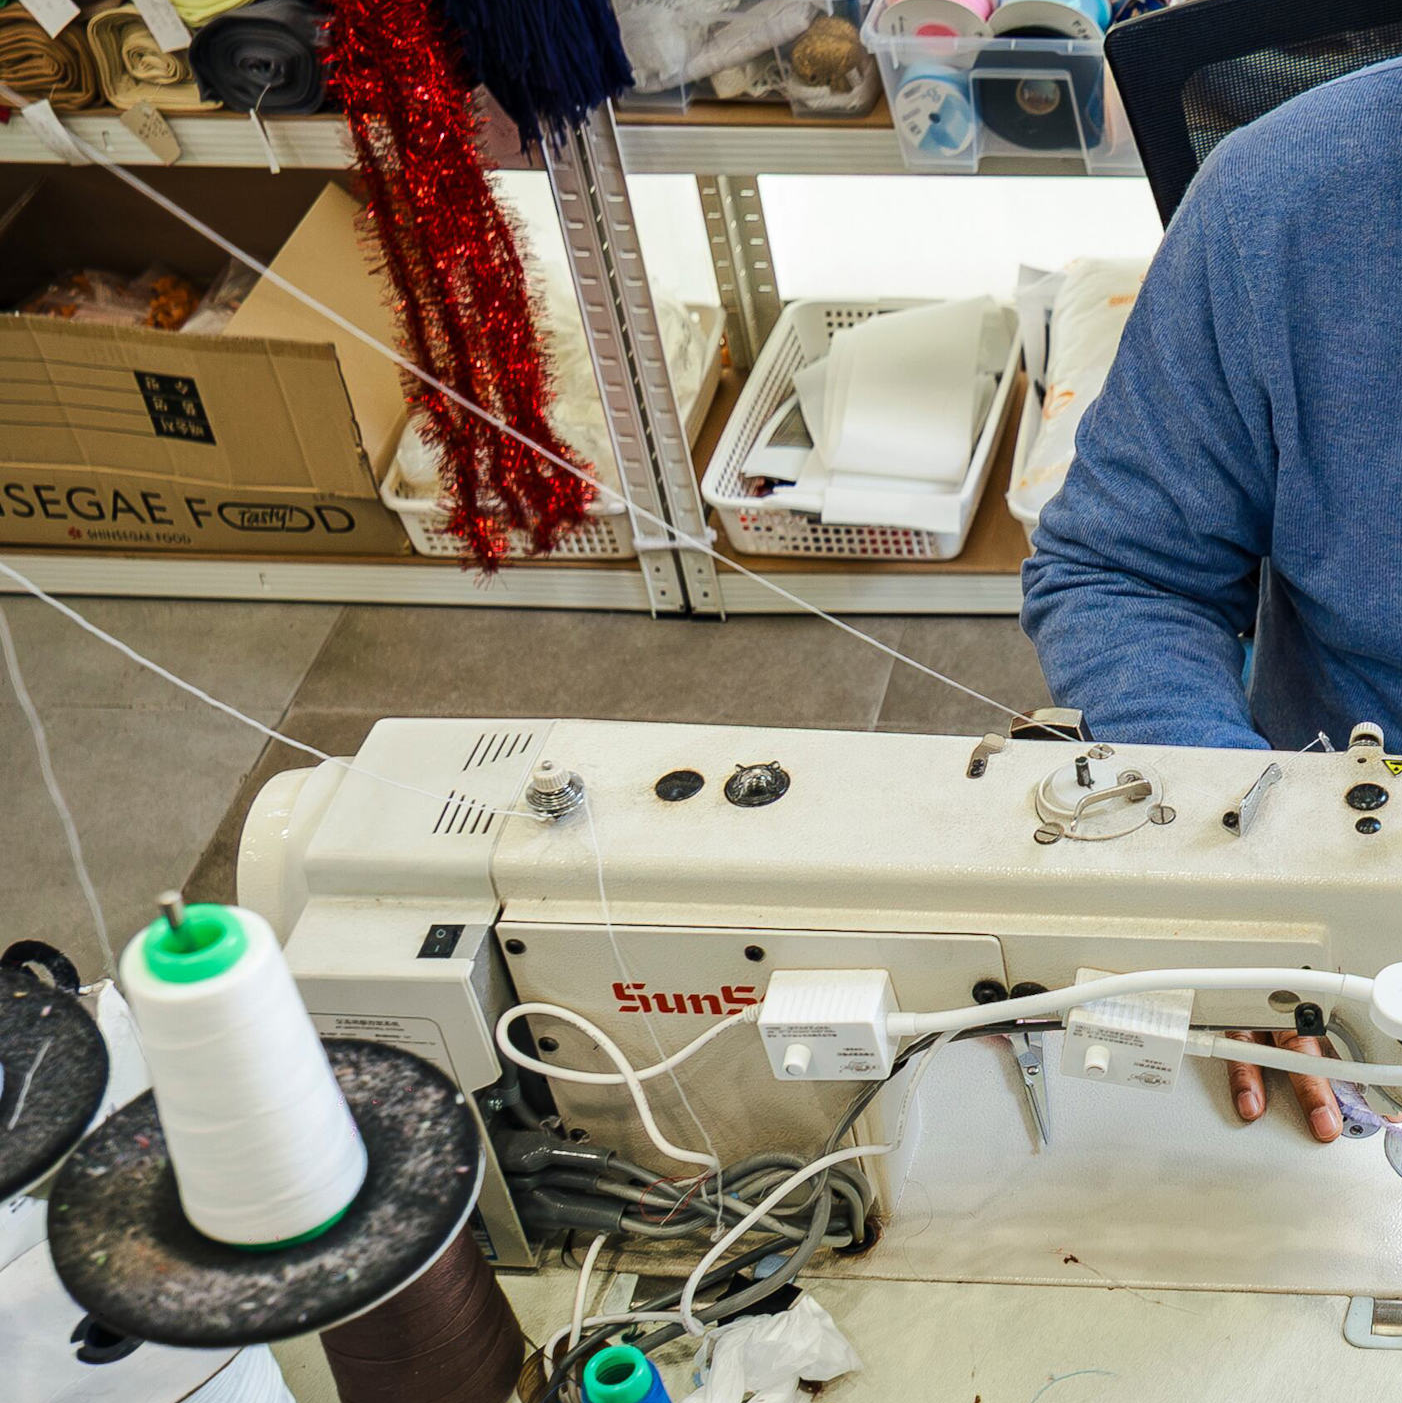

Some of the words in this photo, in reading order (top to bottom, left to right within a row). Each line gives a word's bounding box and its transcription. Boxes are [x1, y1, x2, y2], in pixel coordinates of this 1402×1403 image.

[0, 482, 174, 525] SEGAE
[237, 506, 295, 529] Tasty!
[155, 532, 192, 544] FOOD
[611, 982, 767, 1016] SunS
